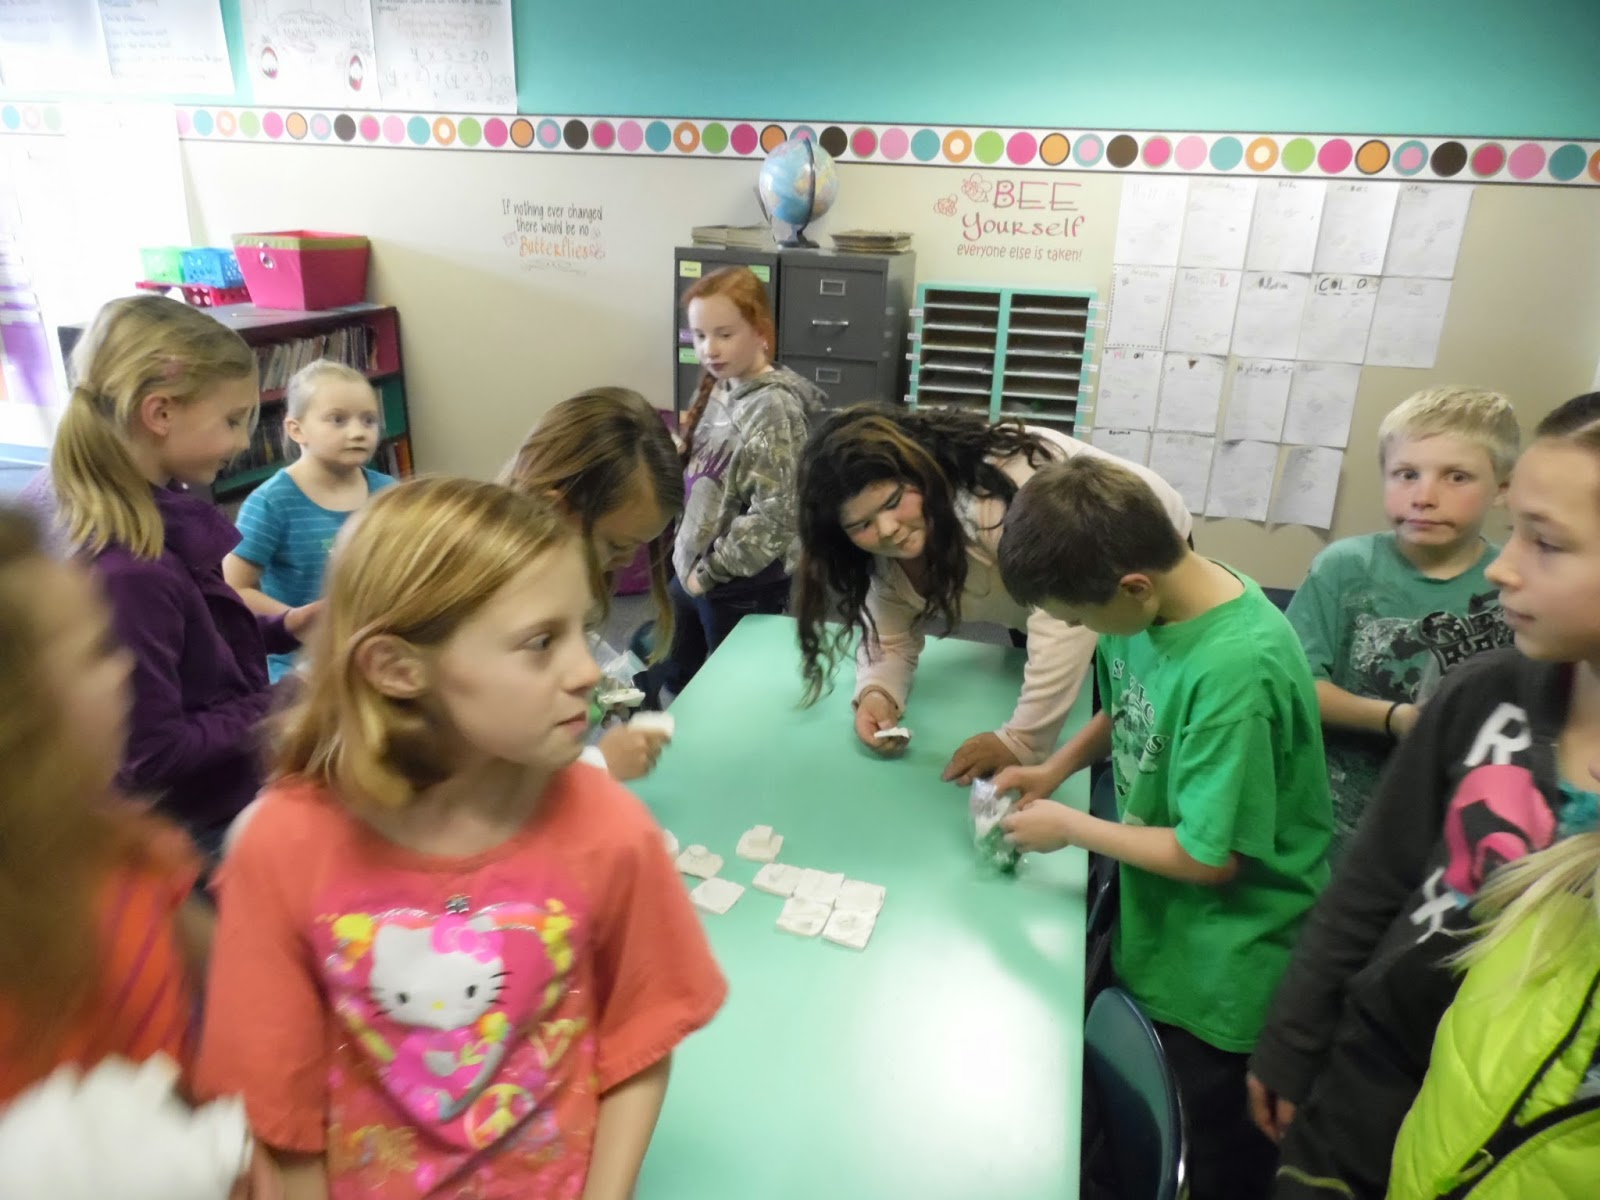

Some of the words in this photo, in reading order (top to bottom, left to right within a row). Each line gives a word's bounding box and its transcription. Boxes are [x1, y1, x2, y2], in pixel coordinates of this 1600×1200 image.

[993, 180, 1081, 211] BEE
[502, 198, 511, 216] If
[513, 200, 544, 221] nothing
[547, 205, 564, 219] ever
[568, 204, 603, 224] changed
[516, 218, 538, 233] there
[541, 219, 563, 235] would
[565, 220, 576, 236] be
[579, 224, 589, 237] no
[957, 243, 1009, 258] everyone
[1009, 245, 1032, 260] else
[1034, 245, 1044, 260] is
[1047, 246, 1084, 263] taken!
